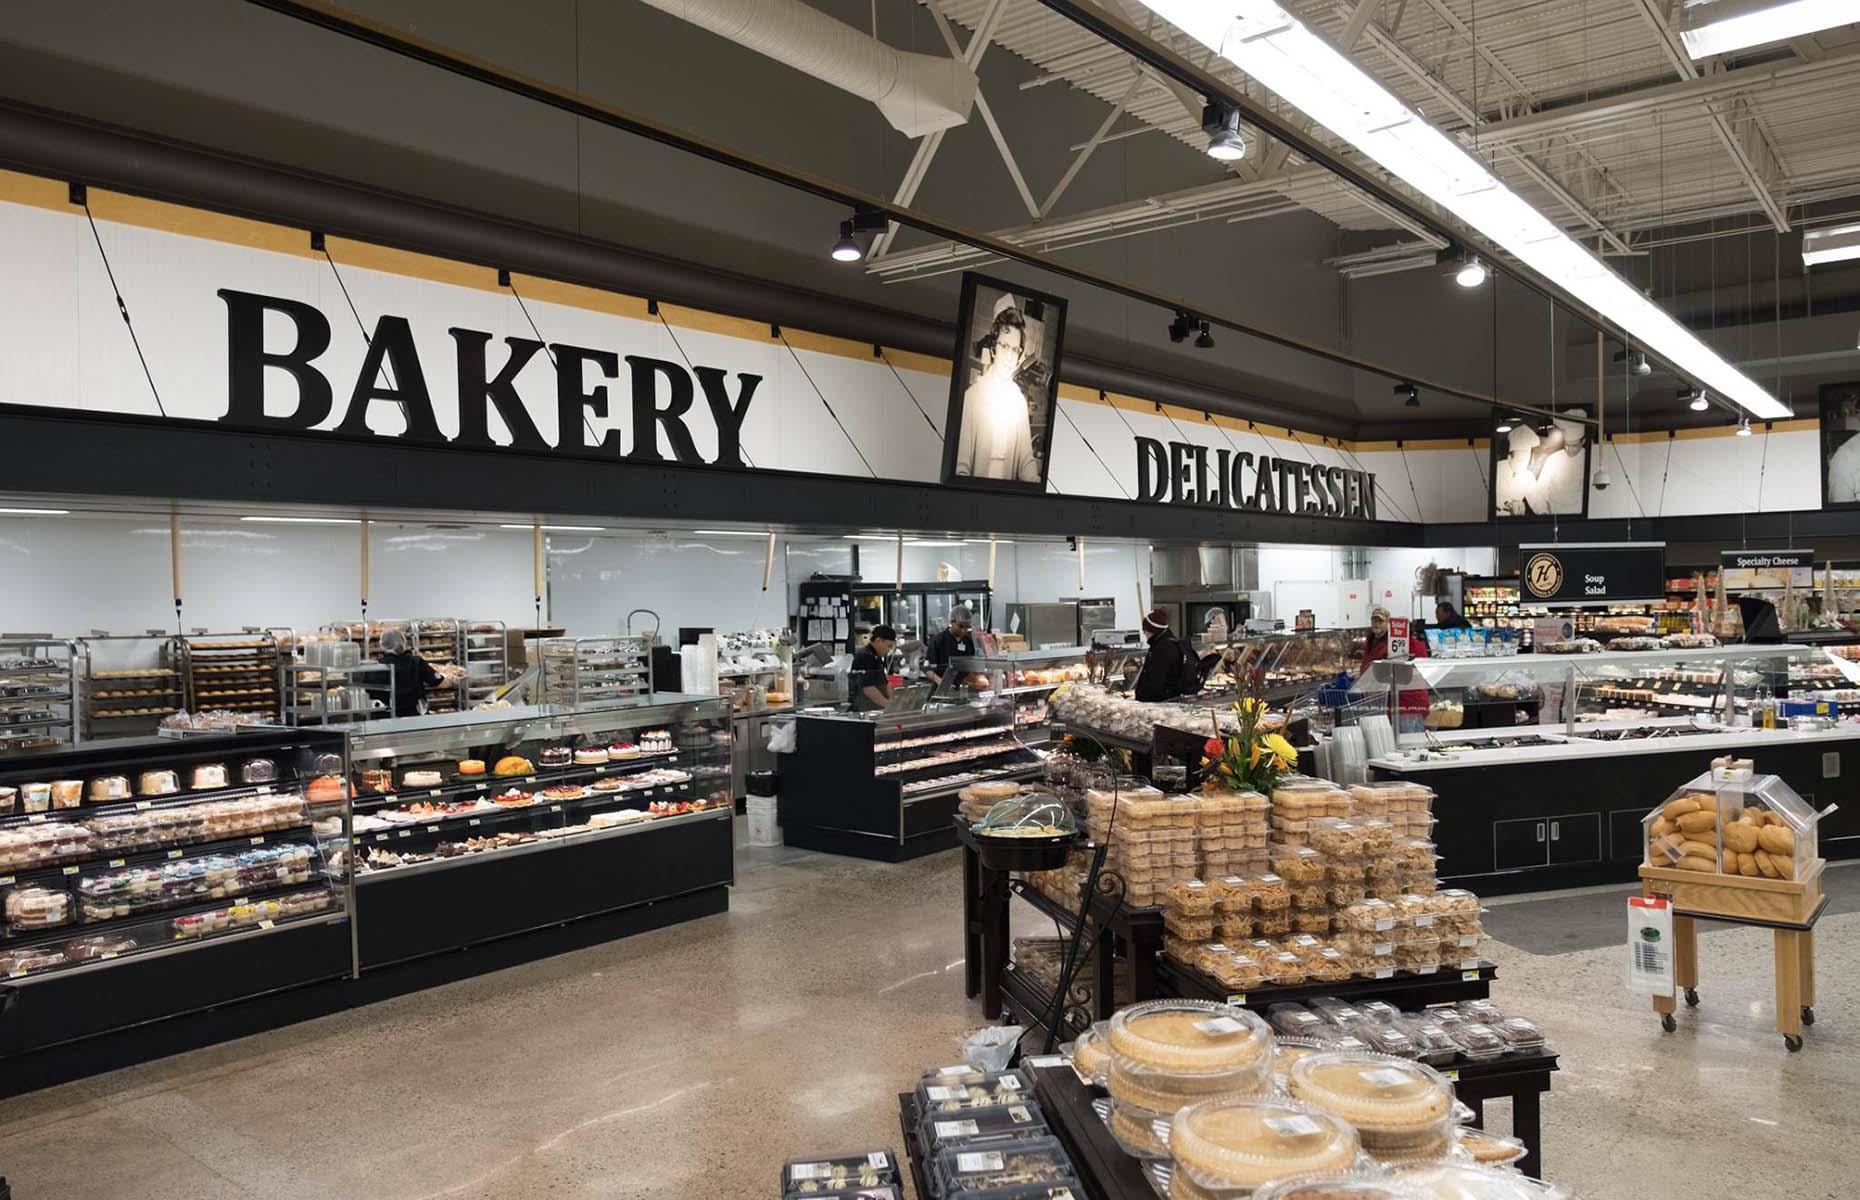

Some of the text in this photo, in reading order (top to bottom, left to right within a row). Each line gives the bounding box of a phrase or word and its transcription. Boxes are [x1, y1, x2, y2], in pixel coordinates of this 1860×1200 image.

[217, 288, 763, 467] BAKERY
[1134, 436, 1377, 520] DELICATESSEN
[1737, 557, 1799, 568] Specialty Cheese
[1537, 563, 1553, 584] H
[1584, 574, 1605, 584] Soup
[1584, 586, 1606, 595] Salad
